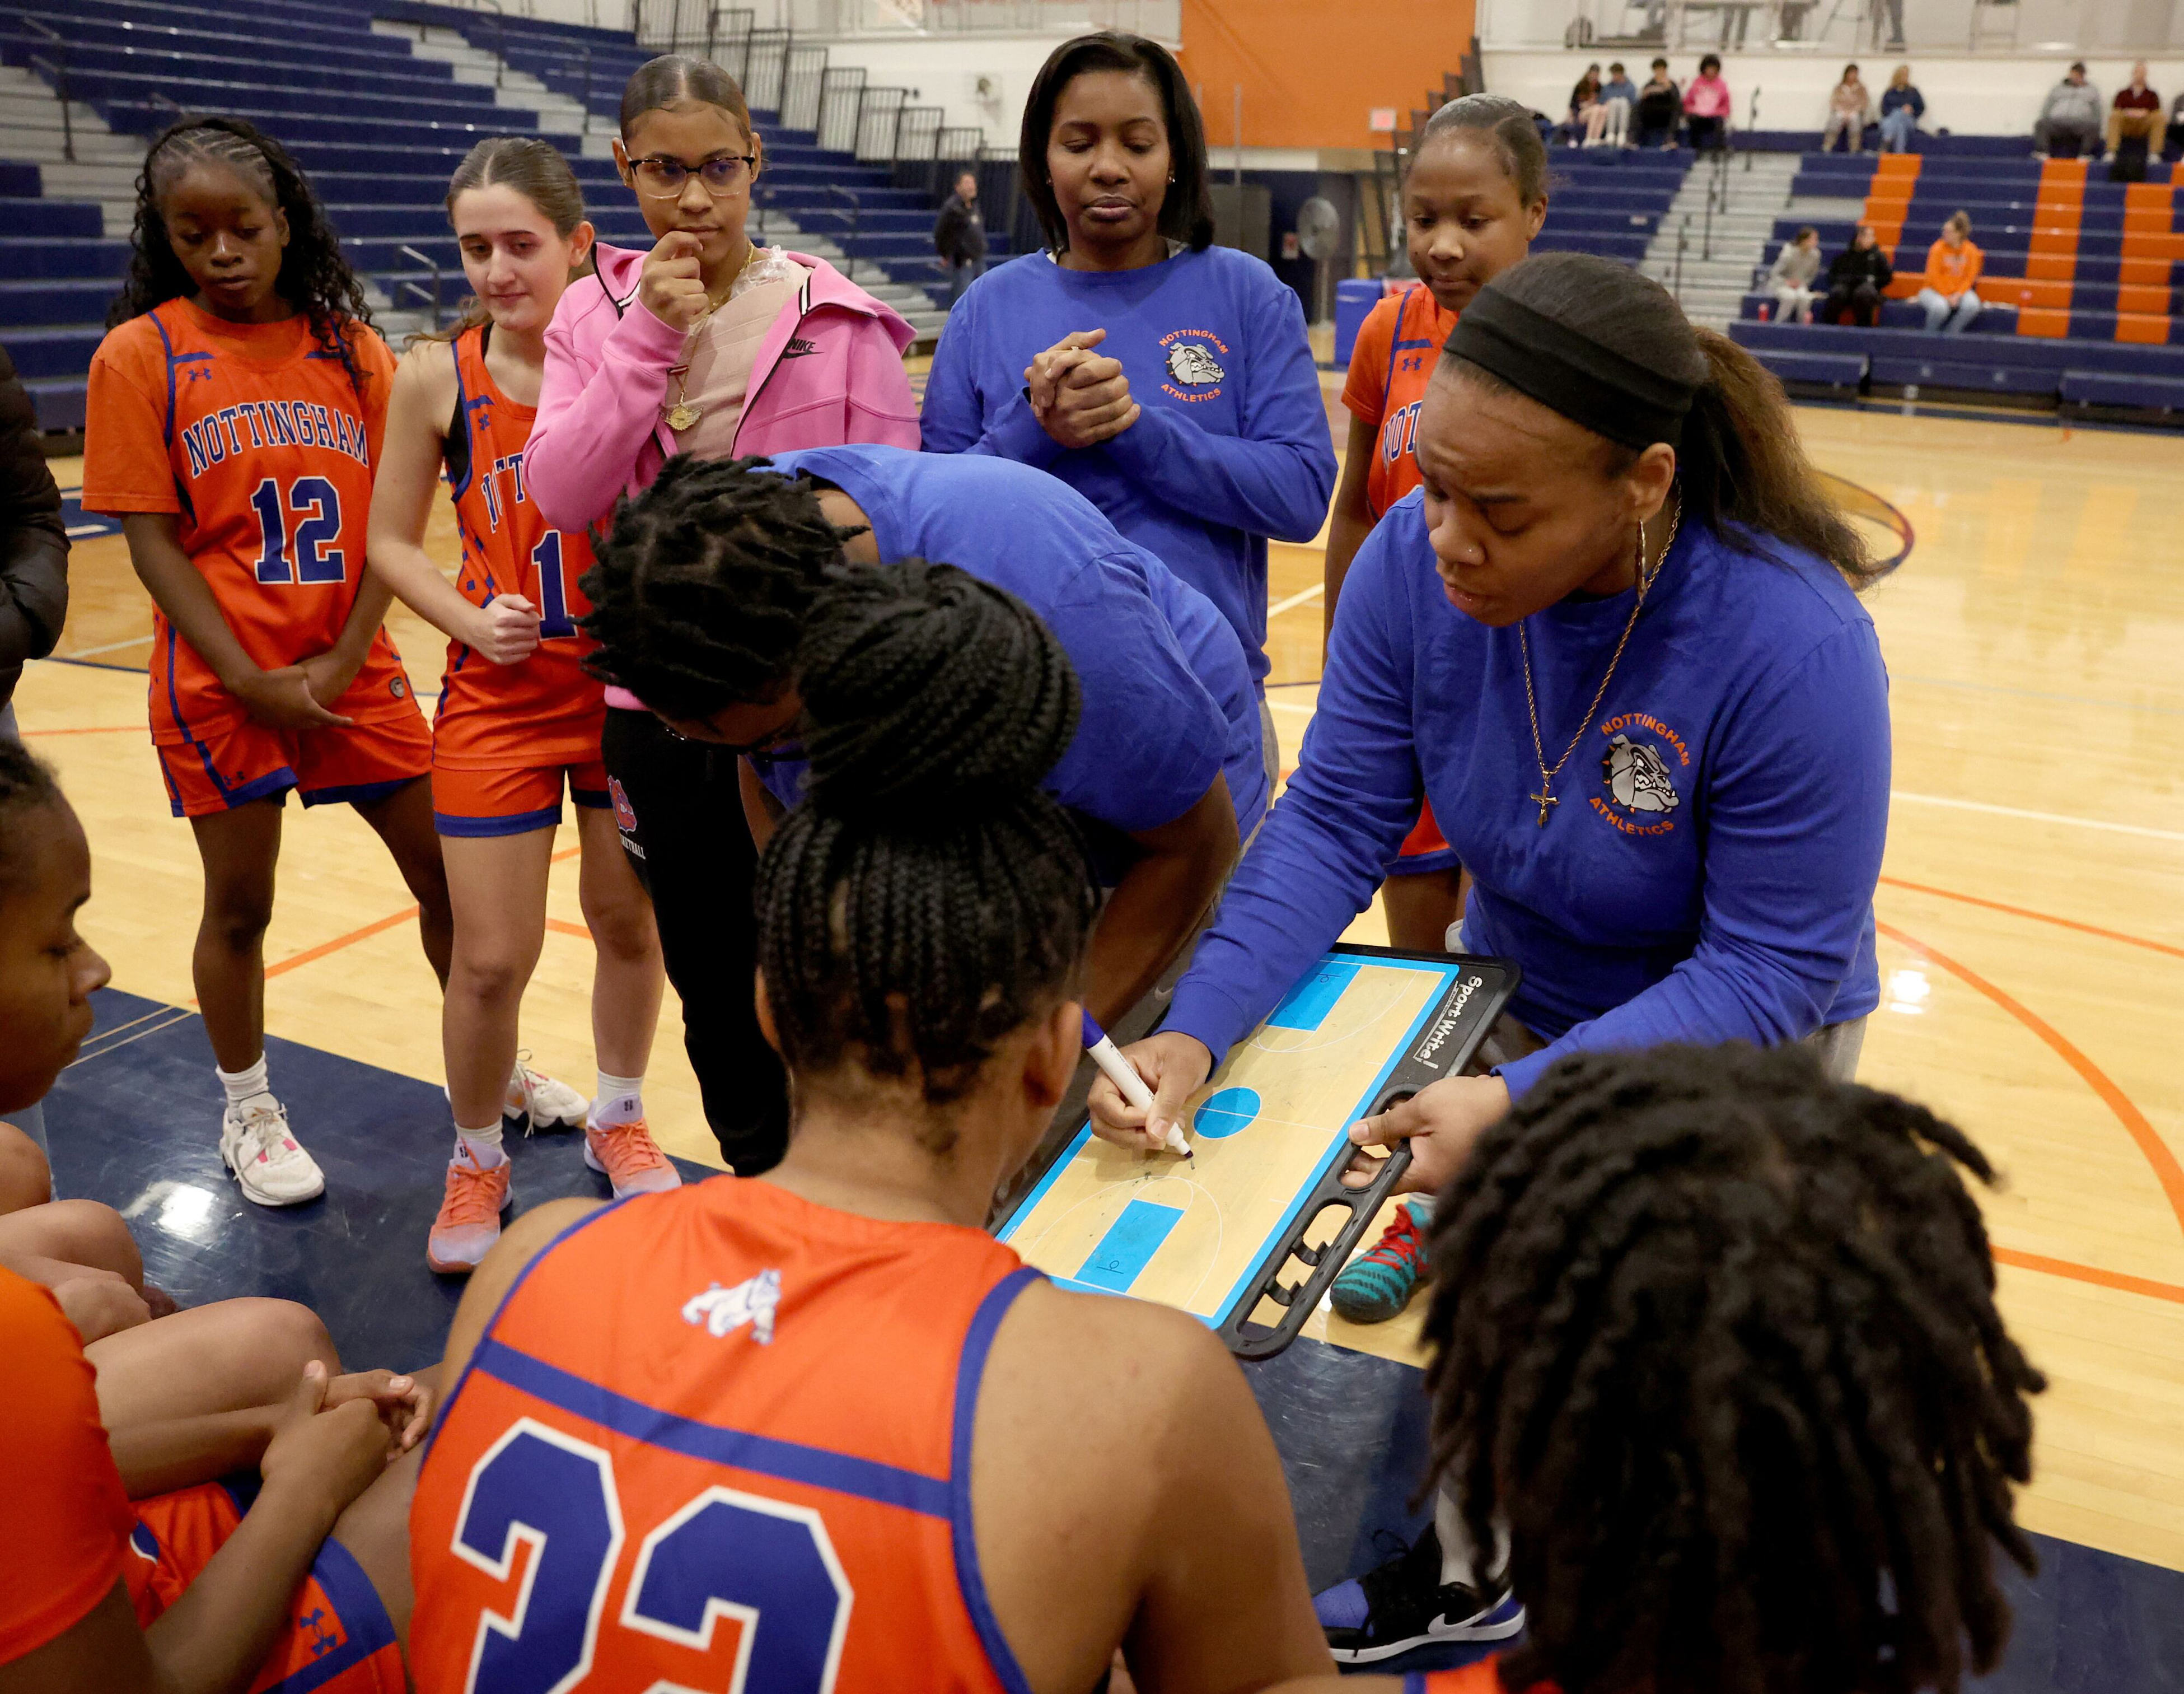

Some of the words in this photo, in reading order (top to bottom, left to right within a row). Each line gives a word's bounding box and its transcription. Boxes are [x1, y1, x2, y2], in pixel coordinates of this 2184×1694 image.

[786, 338, 816, 352] NIKE
[1158, 329, 1229, 354] NOTTINGHAM
[1161, 384, 1222, 402] ATHLETICS
[181, 400, 369, 479] NOTTINGHAM
[250, 476, 347, 585] 12
[531, 529, 579, 641] 1
[1601, 713, 1690, 766] NOTTINGHAM
[1589, 797, 1674, 836] ATHLETICS
[1447, 976, 1482, 1018] Sport
[1414, 1019, 1457, 1069] Write!
